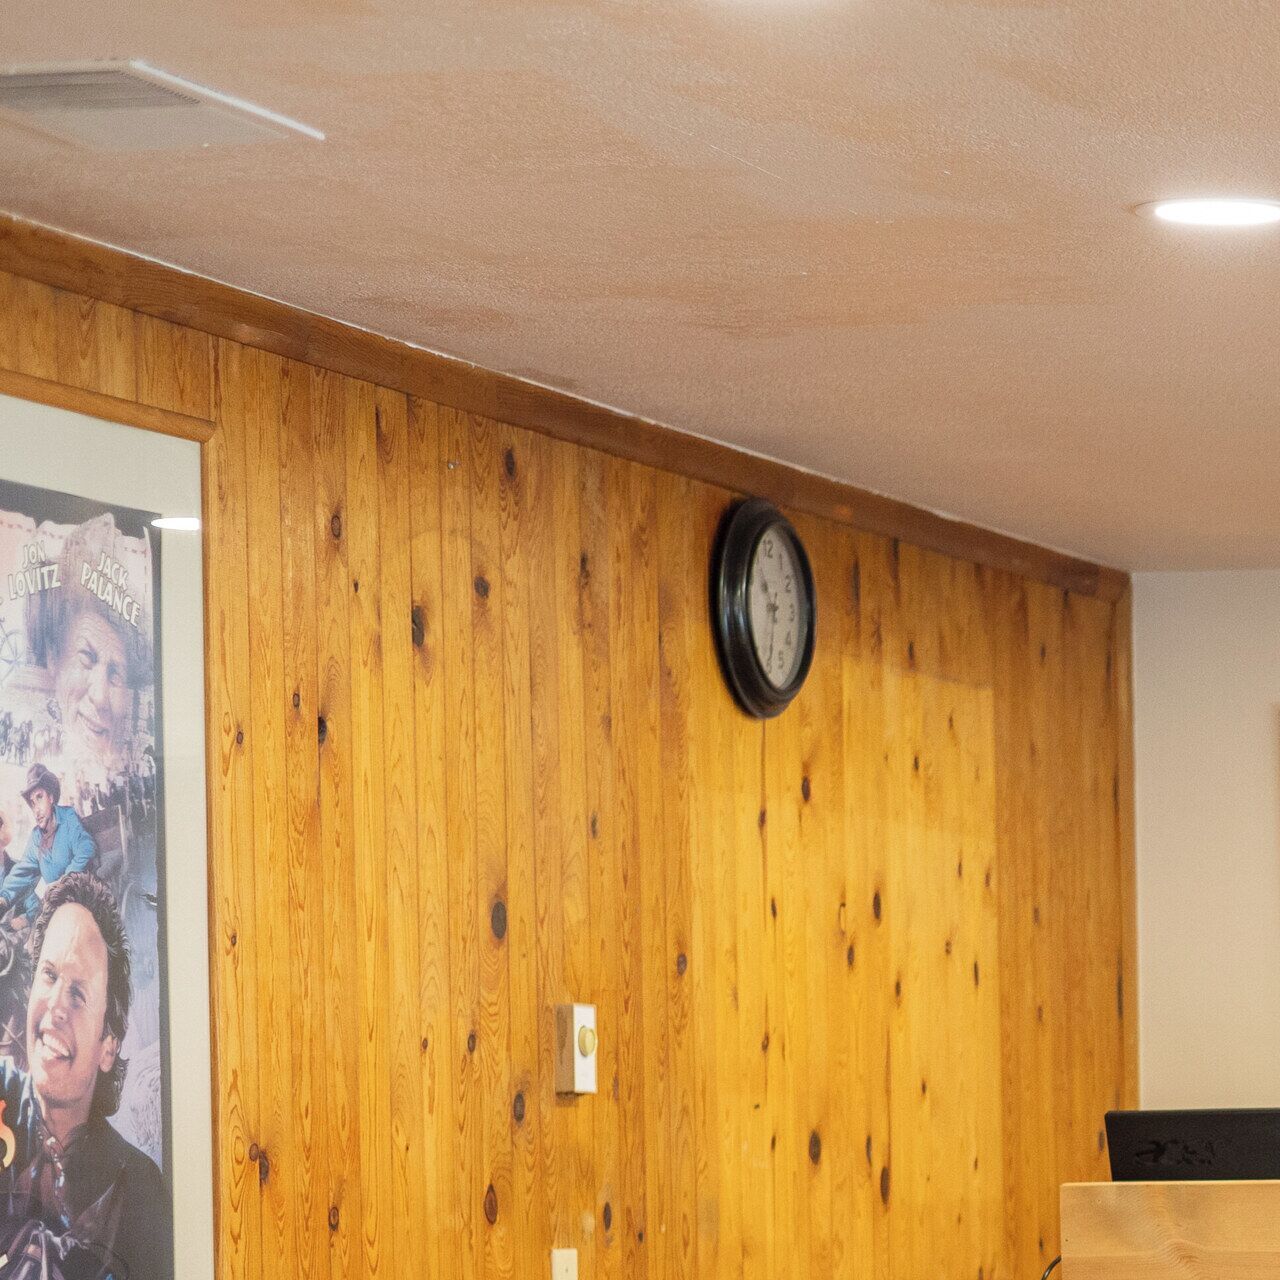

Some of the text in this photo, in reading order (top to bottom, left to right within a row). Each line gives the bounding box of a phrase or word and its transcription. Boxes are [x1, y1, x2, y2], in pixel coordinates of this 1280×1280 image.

[22, 540, 46, 570] JON
[97, 551, 129, 591] JACK
[7, 563, 62, 601] LOVITZ
[80, 561, 141, 628] PALANCE
